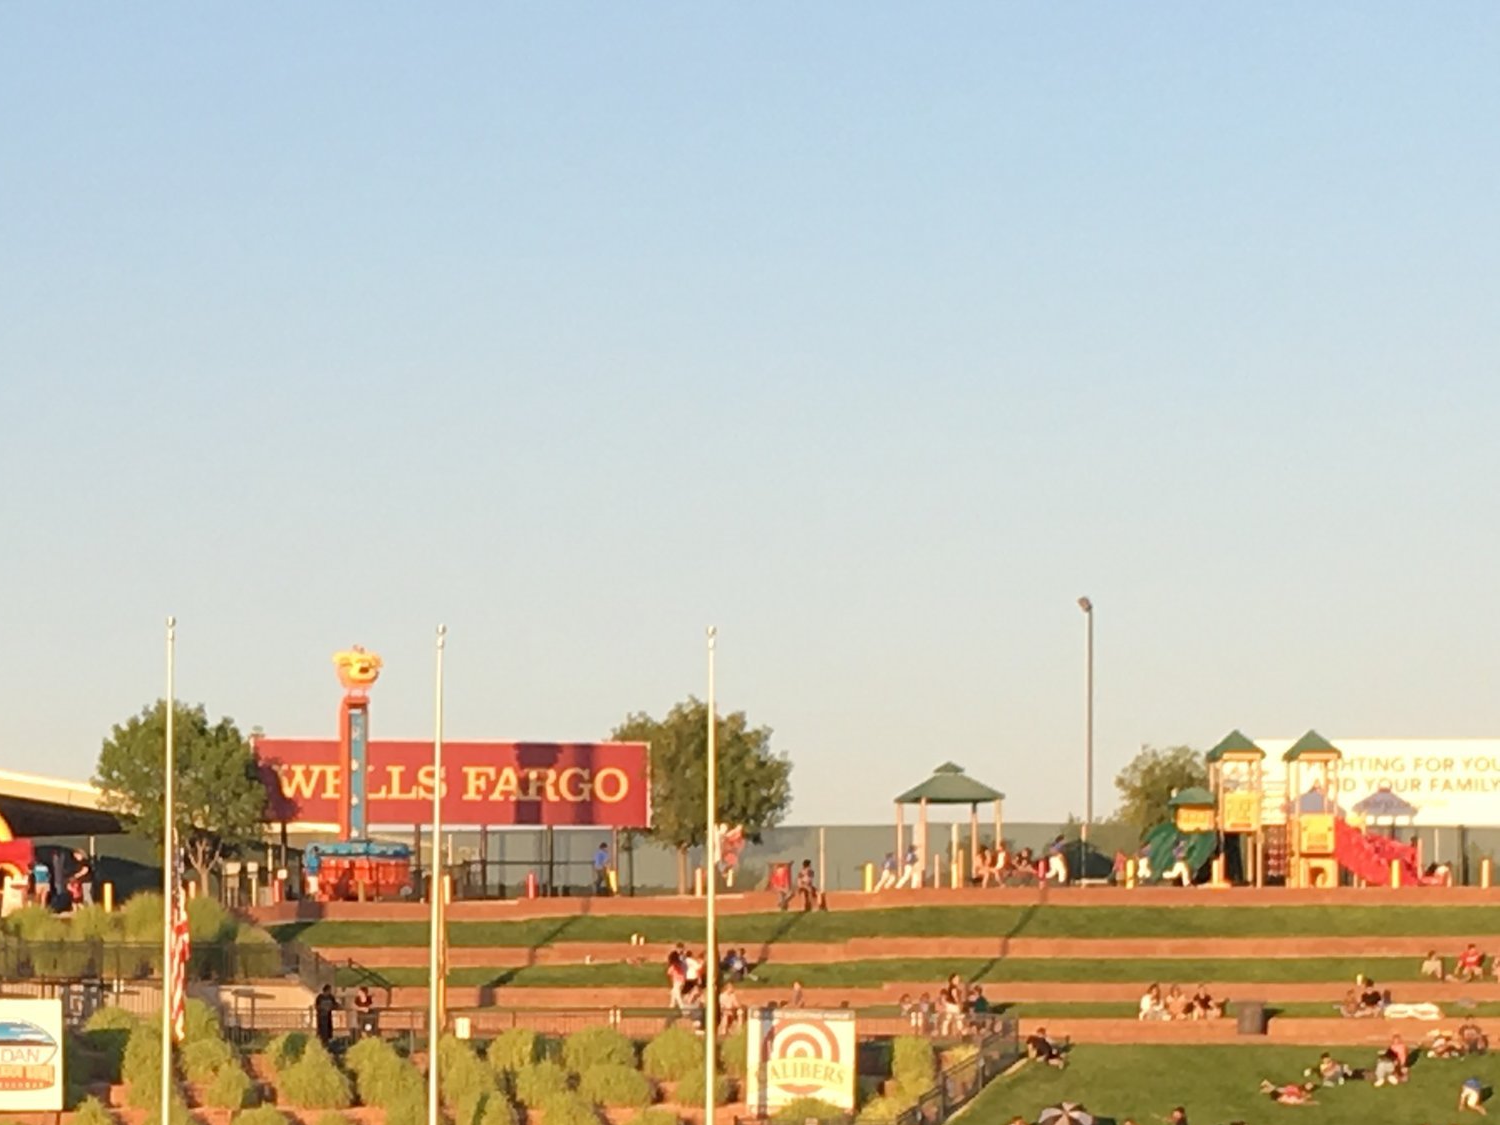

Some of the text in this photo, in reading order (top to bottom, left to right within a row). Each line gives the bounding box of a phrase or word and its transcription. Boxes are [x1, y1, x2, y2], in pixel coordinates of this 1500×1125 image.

[1413, 757, 1454, 772] FOR
[462, 766, 629, 803] FARGO
[1364, 778, 1421, 793] YOUR
[1430, 778, 1500, 793] FAMILY
